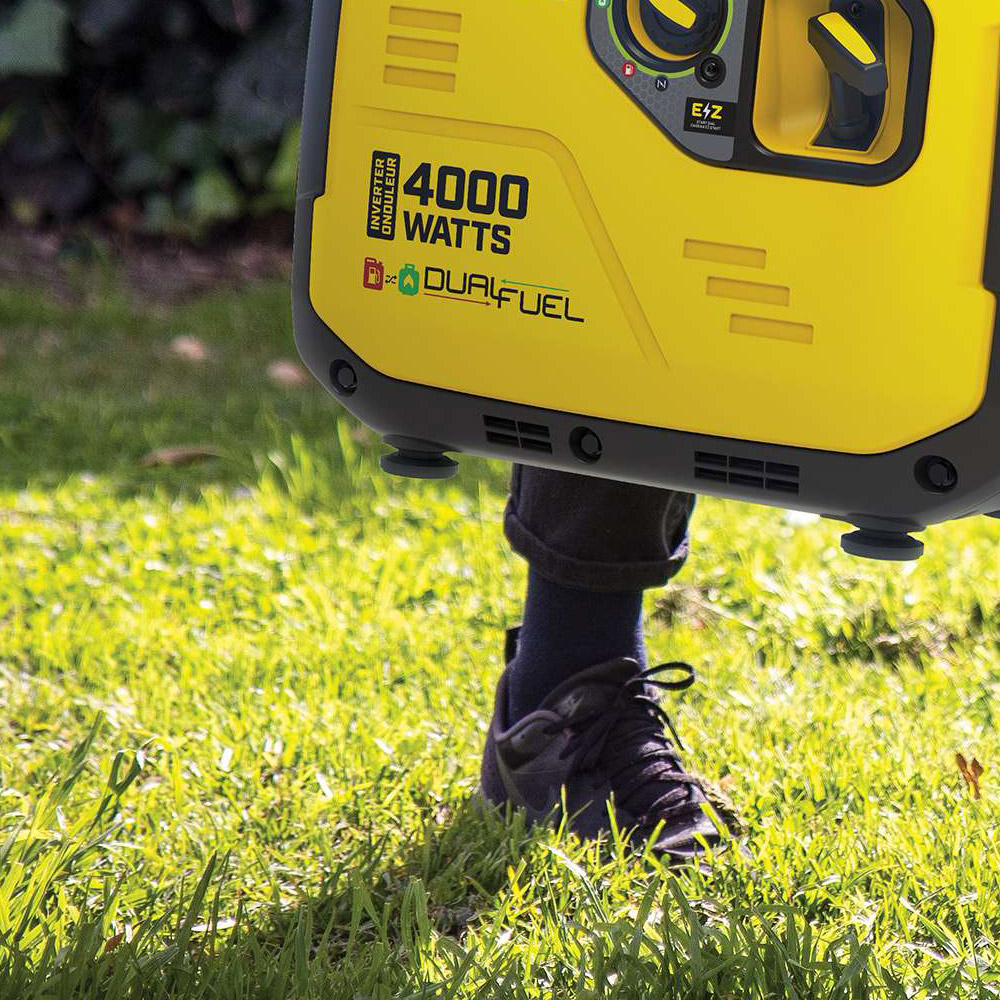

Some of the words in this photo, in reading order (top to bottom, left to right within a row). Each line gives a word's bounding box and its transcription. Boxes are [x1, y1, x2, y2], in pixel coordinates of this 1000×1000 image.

[370, 158, 385, 231] INVERTER
[381, 157, 397, 236] ONDULEUR
[403, 162, 529, 220] 4000
[403, 210, 511, 255] WATTS
